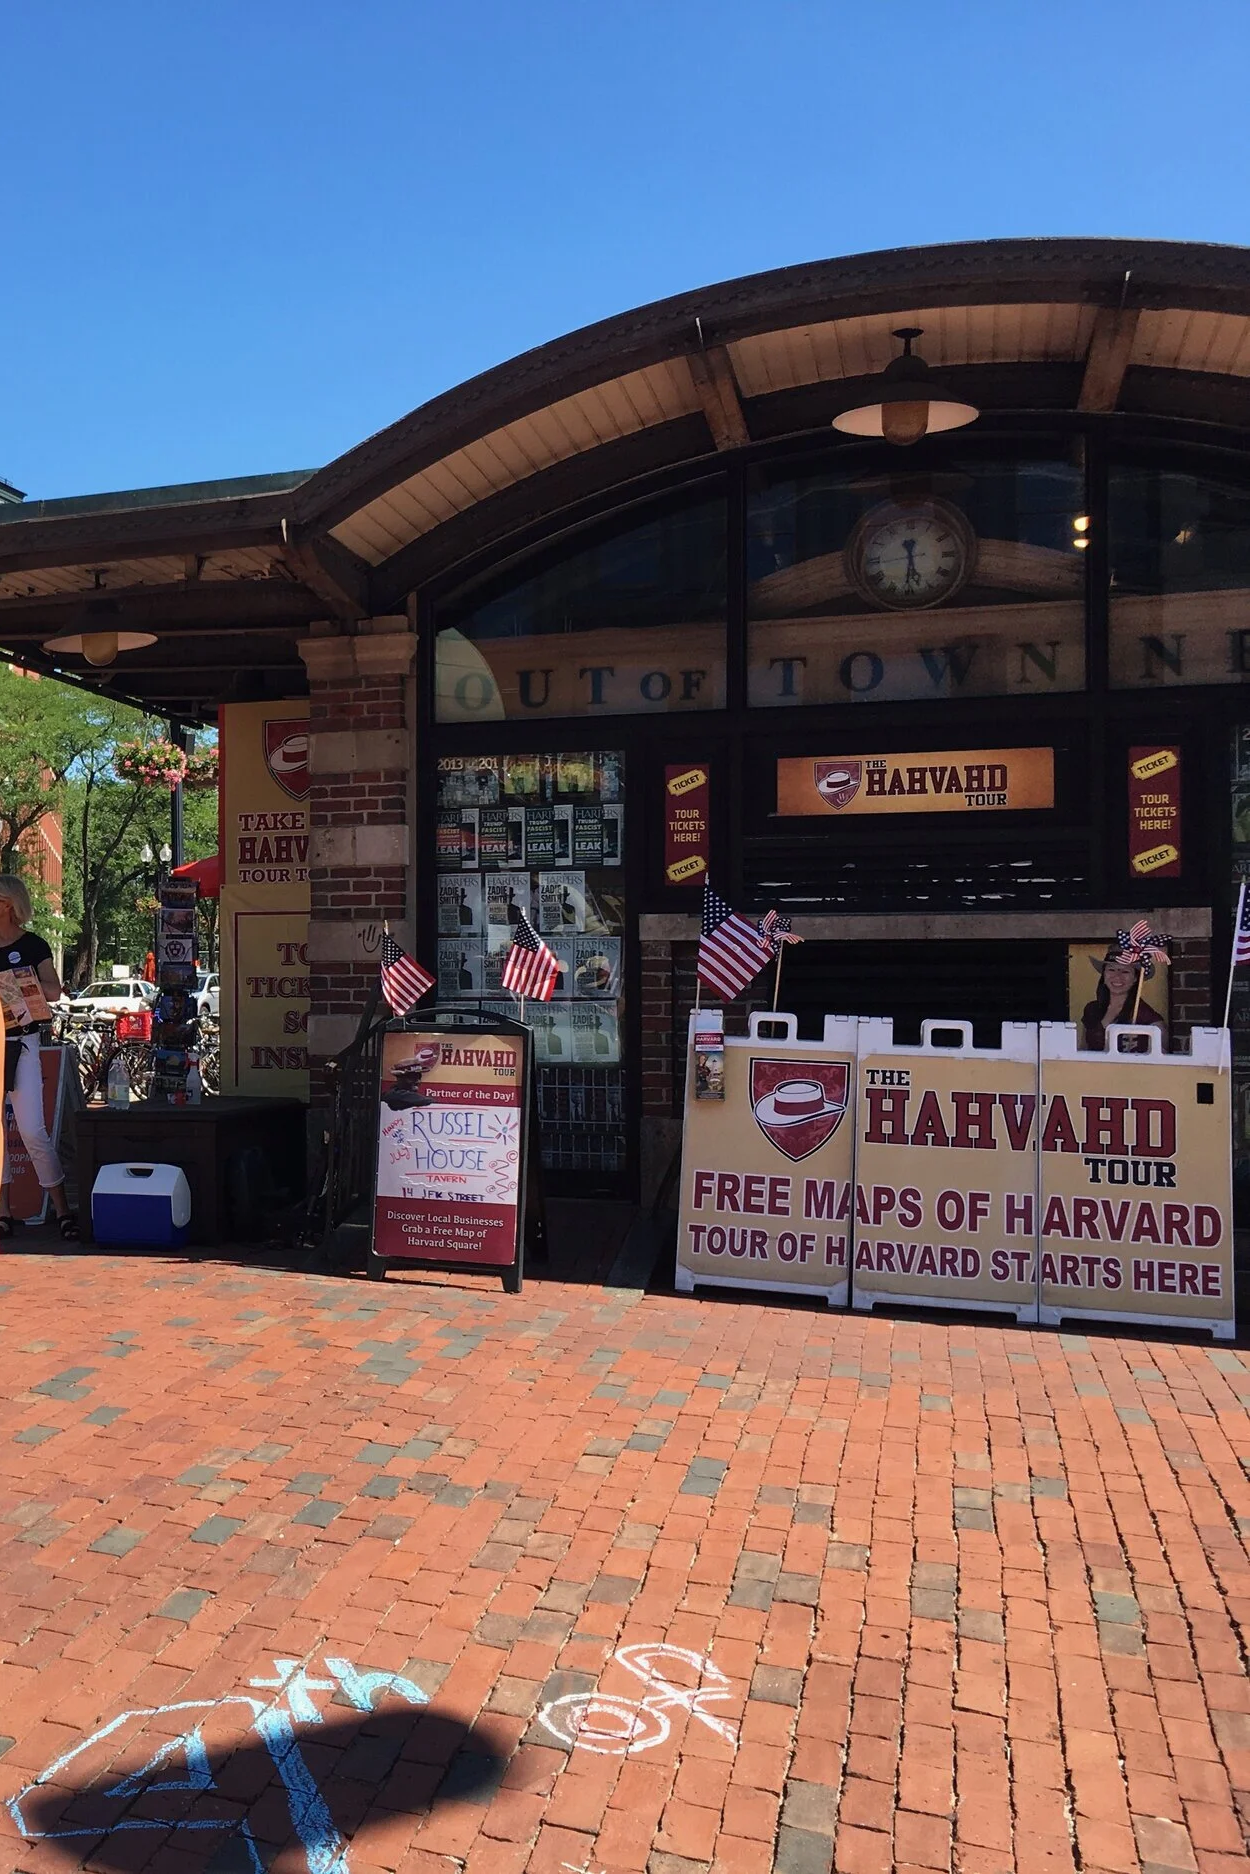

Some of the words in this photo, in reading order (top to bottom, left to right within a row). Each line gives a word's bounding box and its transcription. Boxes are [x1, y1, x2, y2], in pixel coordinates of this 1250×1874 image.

[453, 666, 615, 714] OUT
[639, 667, 708, 702] OF
[769, 641, 1061, 698] TOWN
[865, 760, 886, 769] THE
[1137, 756, 1169, 774] TICKET
[672, 773, 700, 791] TICKET
[865, 763, 1008, 796] HAHVAHD
[965, 793, 1008, 807] TOUR
[1140, 794, 1169, 804] TOUR
[675, 809, 699, 819] TOUR
[1134, 806, 1177, 818] TICKETS
[238, 812, 305, 832] TAKE
[669, 821, 705, 831] TICKETS
[1139, 819, 1171, 830] HERE!
[673, 833, 701, 842] HERE!
[238, 835, 310, 864] HAHV
[481, 844, 507, 853] LEAK
[527, 843, 553, 851] LEAK
[575, 841, 601, 850] LEAK
[1138, 849, 1171, 868] TICKET
[672, 860, 699, 877] TICKET
[238, 868, 291, 883] TOUR
[439, 887, 459, 896] ZADIE
[487, 886, 508, 895] ZADIE
[541, 885, 562, 894] ZADIE
[439, 896, 460, 904] SMITH
[487, 895, 508, 904] SMITH
[540, 894, 562, 903] SMITH
[439, 951, 460, 961] ZADIE
[440, 960, 460, 969] SMITH
[527, 1015, 548, 1025] ZADIE
[572, 1015, 594, 1024] ZADIE
[441, 1049, 517, 1068] HAHVAHD
[493, 1068, 516, 1076] TOUR
[866, 1069, 911, 1087] THE
[426, 1088, 460, 1099] Partner
[462, 1088, 472, 1099] of
[475, 1089, 491, 1099] the
[493, 1090, 515, 1102] Day!
[382, 1118, 405, 1137] Happy
[410, 1111, 496, 1140] RUSSEL
[864, 1088, 1178, 1158] HAHVAHD
[415, 1148, 488, 1171] HOUSE
[1085, 1157, 1178, 1188] TOUR
[426, 1175, 467, 1184] TAVERN
[402, 1187, 414, 1198] 14
[422, 1188, 443, 1200] JFK
[448, 1191, 485, 1202] STREET
[693, 1170, 792, 1218] FREE
[803, 1178, 923, 1230] MAPS
[936, 1188, 991, 1234] OF
[1005, 1191, 1223, 1250] HARVARD
[387, 1211, 426, 1222] Discover
[428, 1214, 451, 1223] Local
[453, 1216, 504, 1227] Businesses
[402, 1224, 423, 1234] Grab
[433, 1226, 452, 1235] Free
[455, 1228, 475, 1239] Map
[476, 1229, 487, 1238] of
[408, 1237, 444, 1248] Harvard
[447, 1240, 482, 1250] Square!
[688, 1223, 768, 1260] TOUR
[776, 1232, 816, 1267] OF
[823, 1236, 982, 1280] HARVARD
[990, 1250, 1124, 1292] STARTS
[1132, 1258, 1223, 1299] HERE
